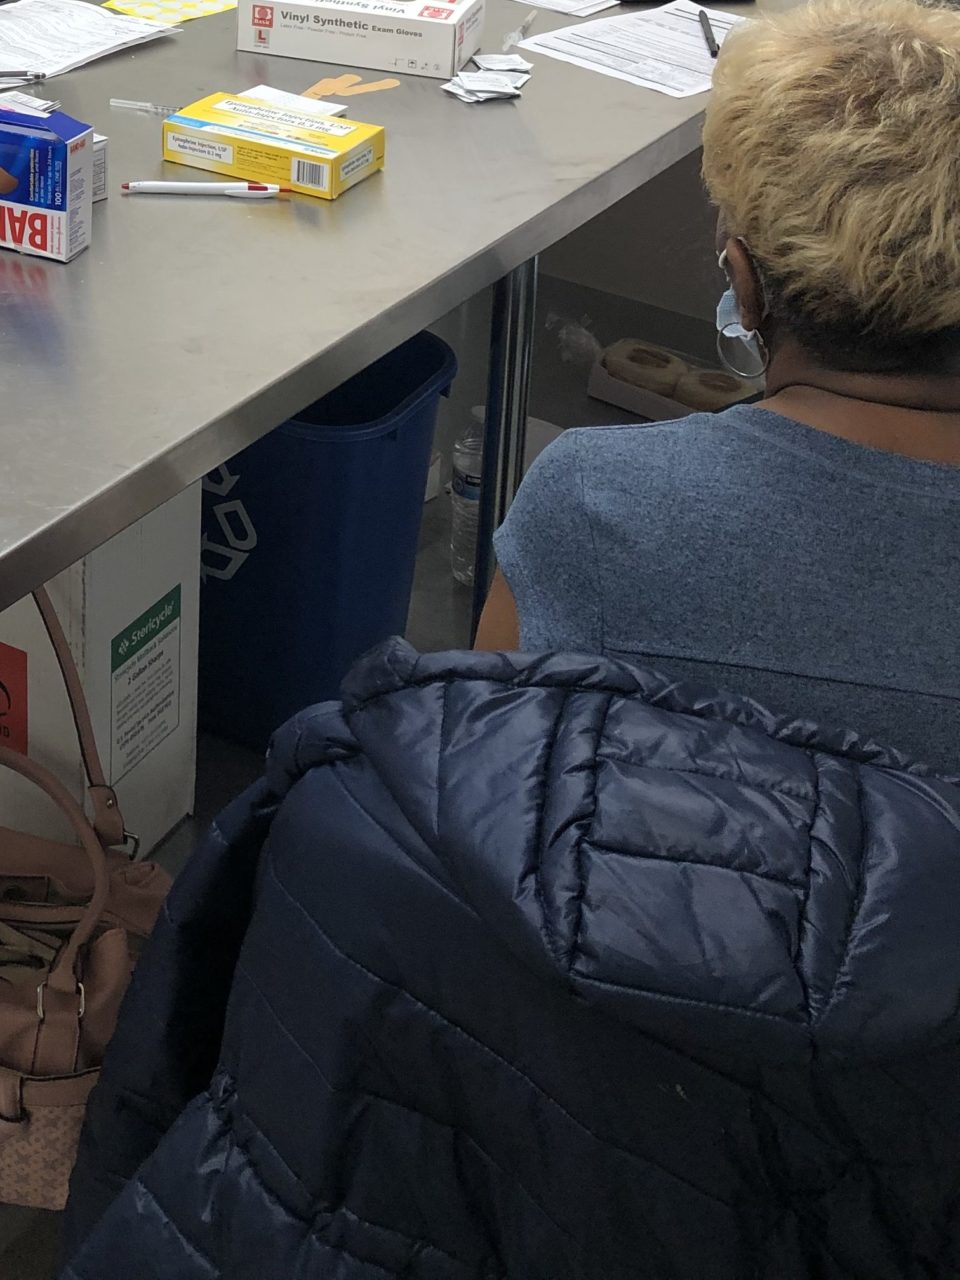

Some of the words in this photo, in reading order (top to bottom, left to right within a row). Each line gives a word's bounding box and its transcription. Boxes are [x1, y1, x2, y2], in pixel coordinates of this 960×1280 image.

[373, 5, 406, 15] Vinyl
[280, 10, 310, 24] Vinyl
[313, 15, 369, 31] Synthetic
[371, 25, 394, 34] Exam
[396, 28, 423, 38] Gloves
[258, 30, 266, 41] L
[131, 604, 173, 646] Stericycle
